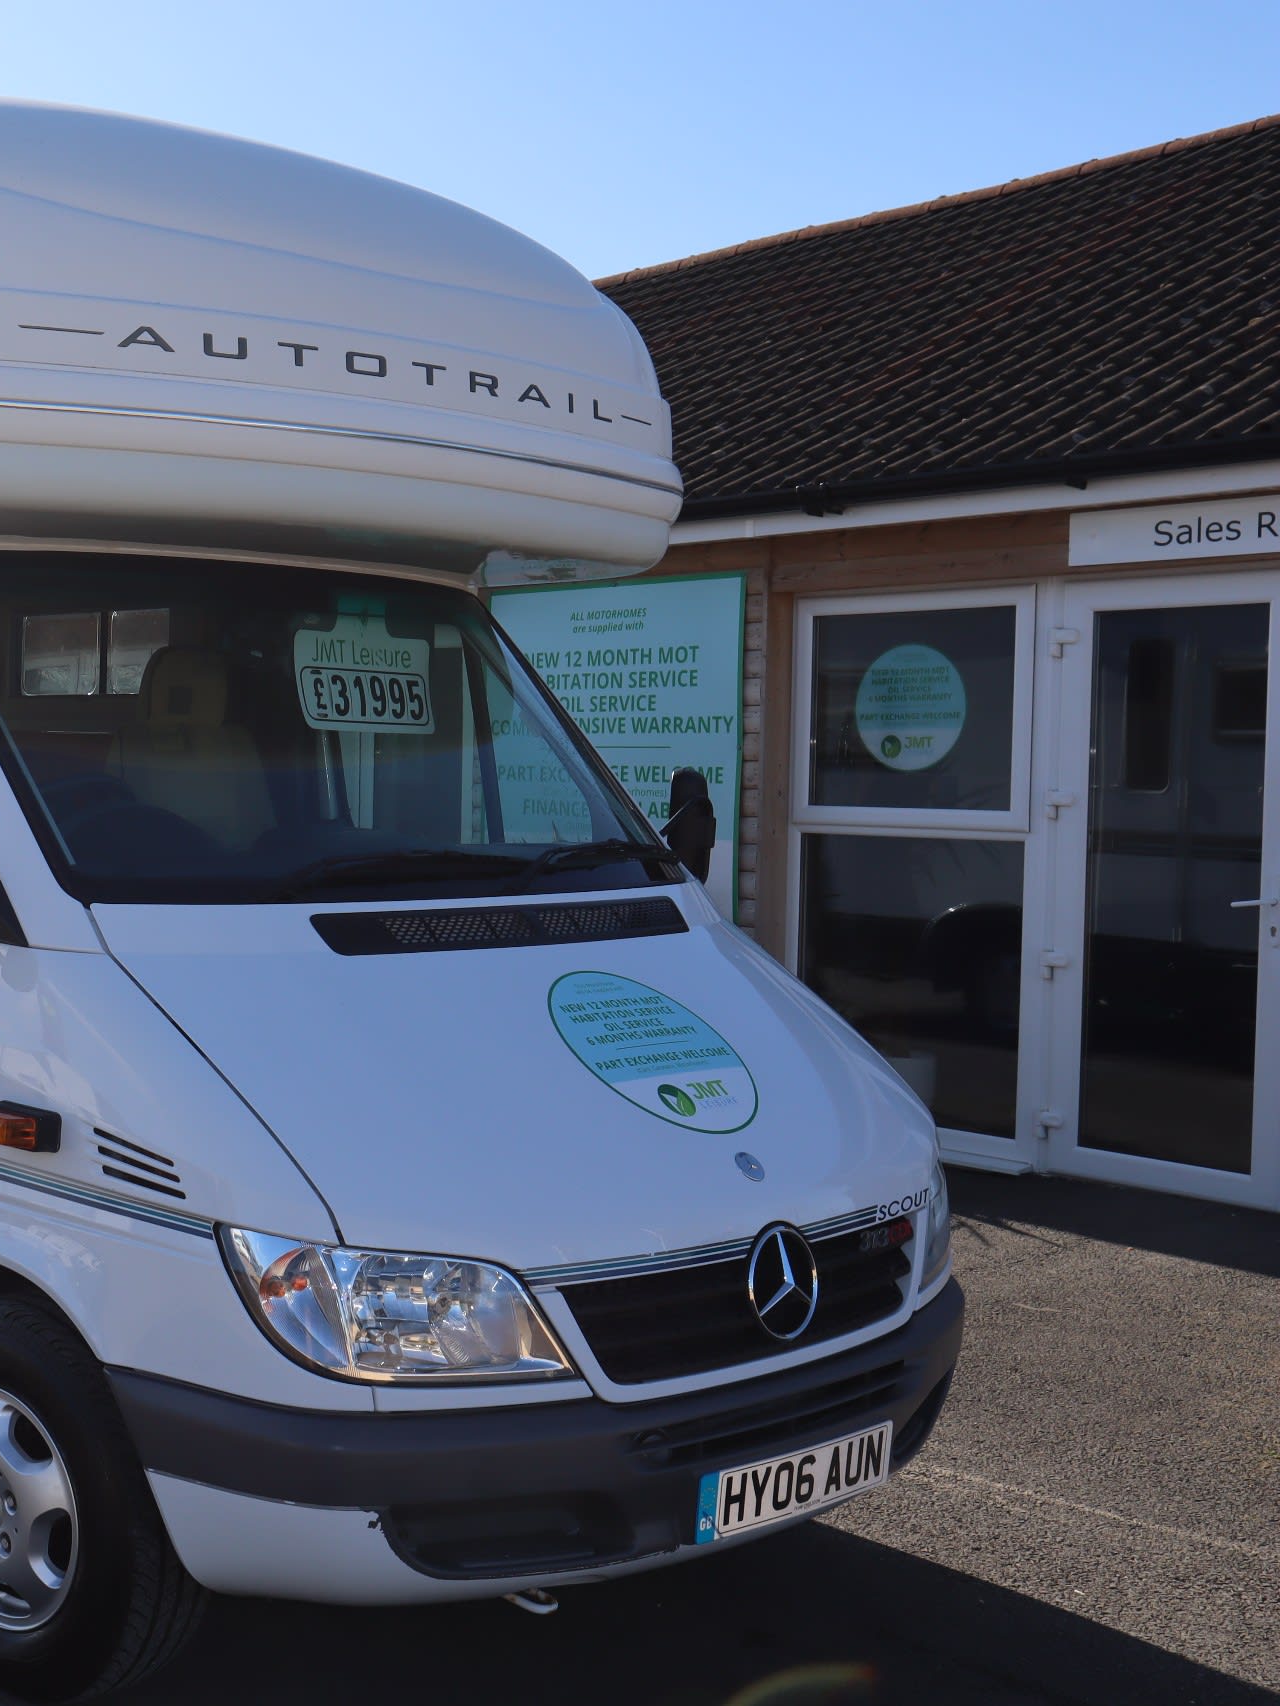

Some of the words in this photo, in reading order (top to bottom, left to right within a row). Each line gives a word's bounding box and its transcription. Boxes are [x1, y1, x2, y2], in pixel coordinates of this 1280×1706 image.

[117, 325, 613, 423] AUTOTRAIL
[1153, 513, 1242, 547] Sales
[570, 610, 585, 621] ALL
[586, 607, 647, 621] MOTORHOMES
[573, 624, 586, 633] are
[587, 621, 623, 634] supplied
[625, 620, 644, 632] with
[312, 638, 346, 662] JMT
[352, 640, 411, 668] Leisure
[564, 651, 582, 667] 12
[587, 648, 652, 667] MONTH
[658, 645, 699, 664] MOT
[546, 670, 623, 690] BITATION
[628, 669, 698, 688] SERVICE
[313, 674, 424, 720] £31995
[589, 694, 657, 712] SERVICE
[631, 715, 734, 734] WARRANTY
[904, 736, 934, 748] JMT
[498, 766, 537, 782] PART
[522, 799, 589, 818] FINANCE
[559, 1002, 587, 1014] NEW
[589, 1000, 601, 1011] 12
[602, 997, 640, 1009] MONTH
[640, 995, 664, 1005] MOT
[569, 1008, 635, 1024] HABITATION
[636, 1005, 676, 1017] SERVICE
[604, 1020, 623, 1032] OIL
[624, 1017, 665, 1030] SERVICE
[586, 1036, 596, 1046] 6
[595, 1030, 646, 1045] MONTHS
[643, 1025, 697, 1038] WARRANTY
[595, 1057, 625, 1072] PART
[626, 1051, 682, 1068] EXCHANGE
[682, 1046, 732, 1060] WELCOME
[686, 1079, 729, 1100] JMT
[877, 1188, 929, 1222] SCOUT
[723, 1454, 816, 1526] HY06
[824, 1430, 885, 1496] AUN
[699, 1514, 713, 1532] GB
